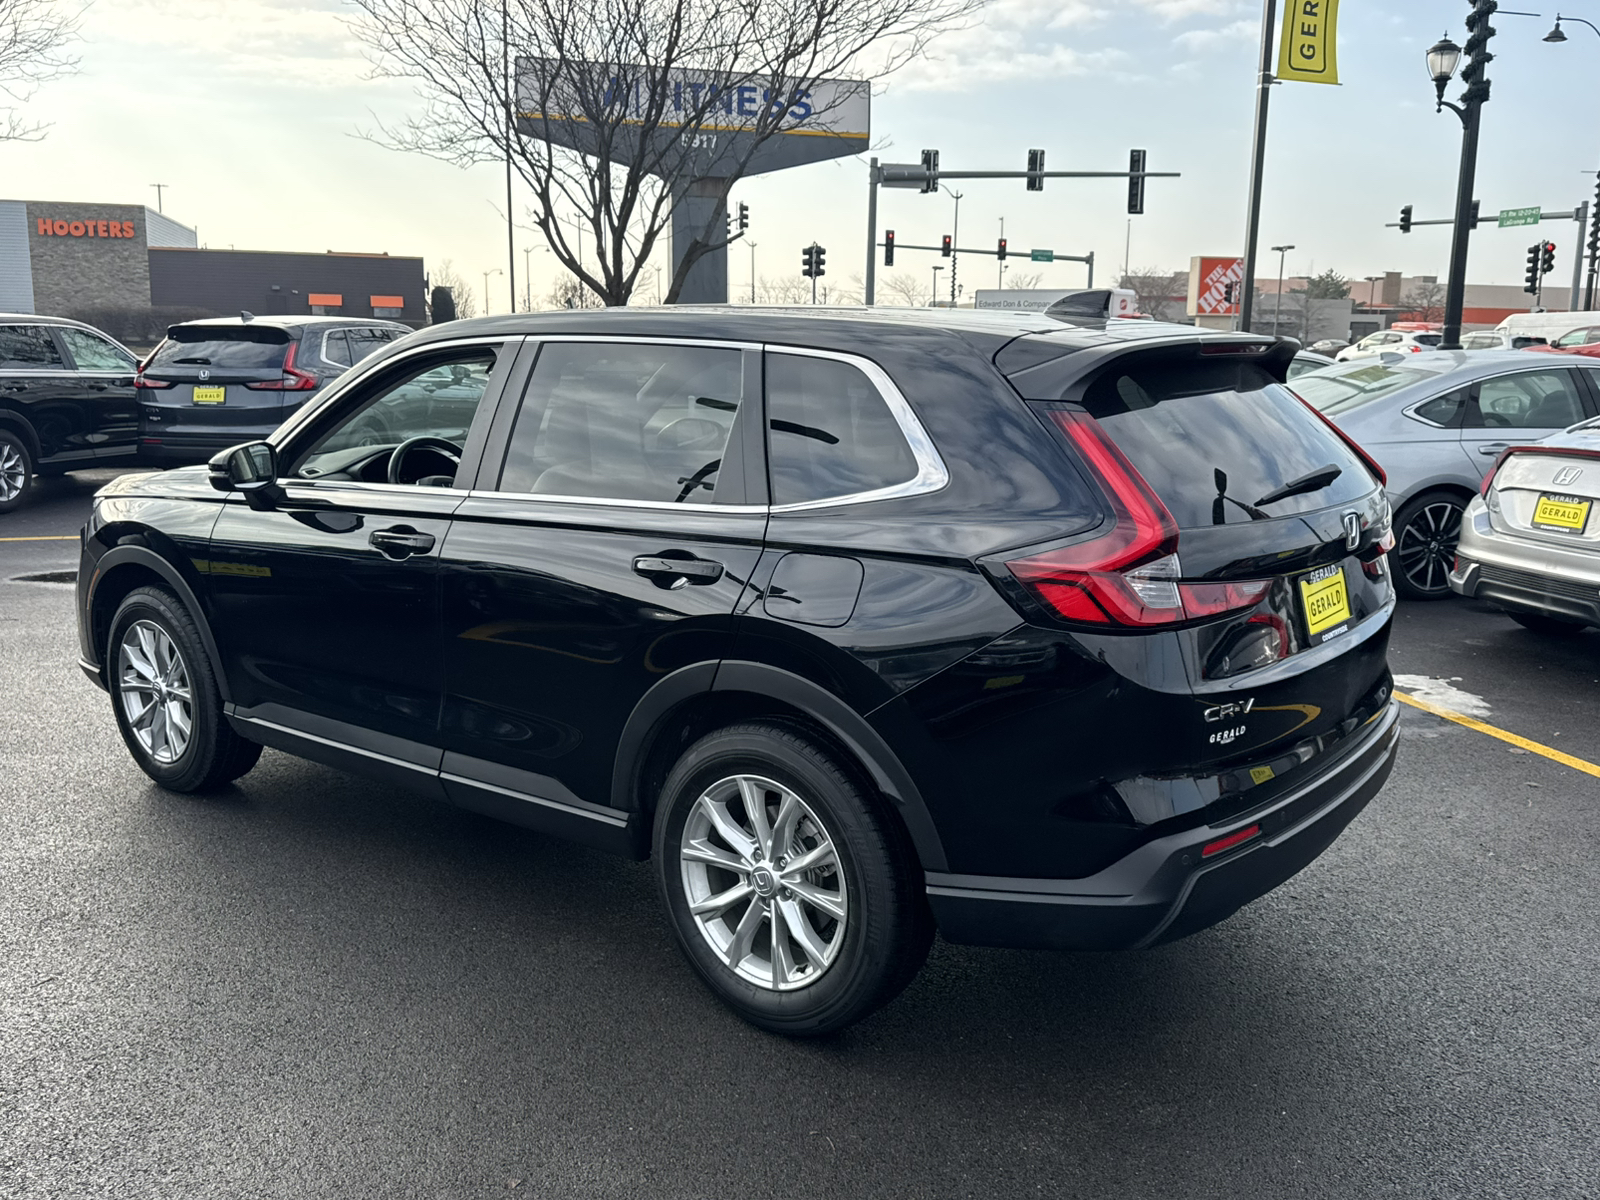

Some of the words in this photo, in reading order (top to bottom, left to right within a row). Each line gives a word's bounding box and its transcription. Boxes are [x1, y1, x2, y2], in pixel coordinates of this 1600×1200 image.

[37, 218, 135, 239] HOOTERS
[1204, 264, 1225, 286] THE
[979, 300, 1002, 308] Edward
[1003, 300, 1016, 308] Don
[1017, 300, 1022, 308] &
[1550, 495, 1579, 504] GERALD
[1542, 507, 1579, 520] GERALD
[1310, 564, 1337, 583] GERALD
[1310, 590, 1342, 617] GERALD
[1209, 725, 1246, 743] GERALD
